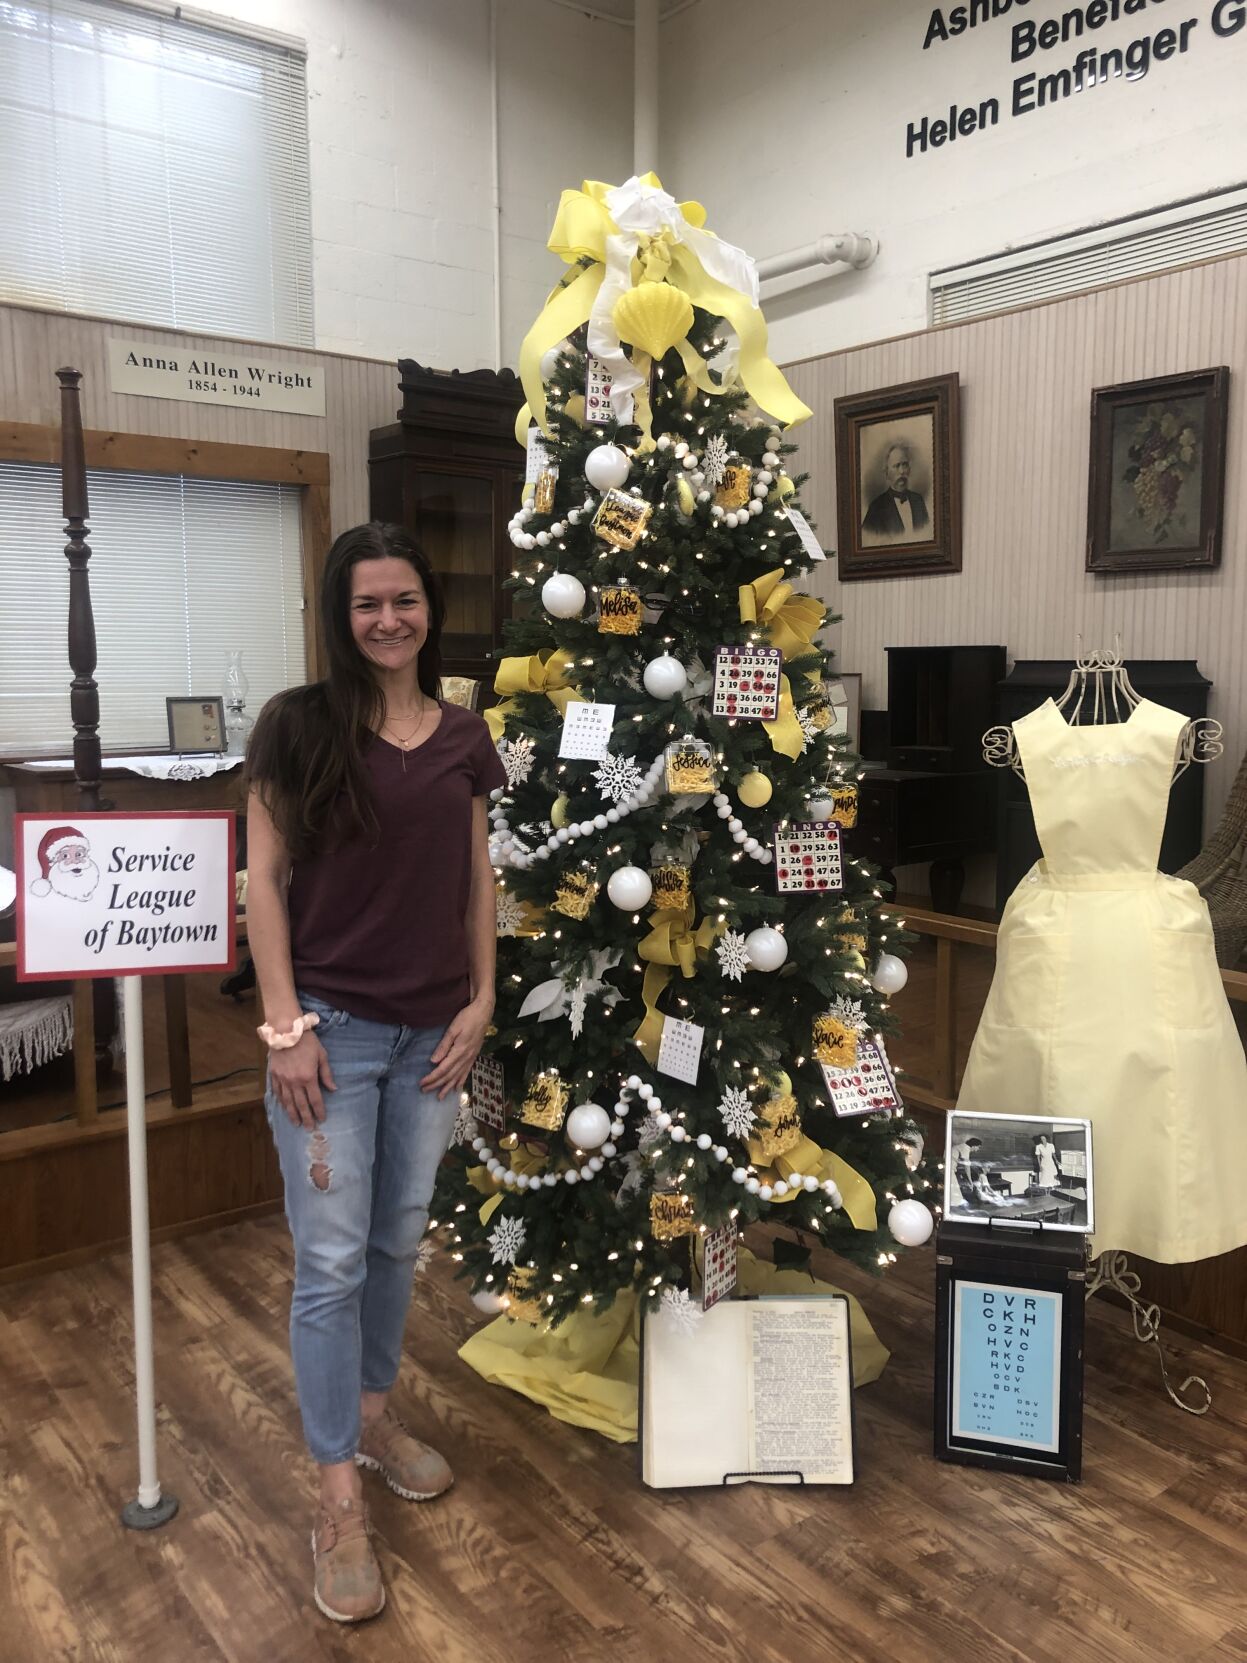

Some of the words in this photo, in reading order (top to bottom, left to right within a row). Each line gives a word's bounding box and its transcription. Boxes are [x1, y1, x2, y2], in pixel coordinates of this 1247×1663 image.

[906, 98, 999, 158] Helen
[1012, 18, 1198, 117] Emfinger
[125, 351, 179, 372] Anna
[188, 360, 239, 379] Allen
[247, 367, 313, 389] Wright
[187, 379, 218, 393] 1854
[232, 384, 261, 398] 1944
[107, 846, 195, 873] Service
[107, 883, 196, 916] League
[84, 920, 114, 954] of
[115, 920, 218, 952] Baytown
[984, 1293, 994, 1304] D
[1005, 1296, 1015, 1306] V
[1025, 1298, 1036, 1310] R
[983, 1308, 994, 1318] C
[1004, 1310, 1014, 1322] K
[1024, 1313, 1035, 1325] H
[988, 1323, 997, 1332] O
[1004, 1326, 1013, 1334] Z
[1020, 1328, 1029, 1337] N
[988, 1337, 996, 1346] H
[1004, 1339, 1012, 1348] V
[1020, 1342, 1028, 1350] C
[1004, 1352, 1011, 1360] K
